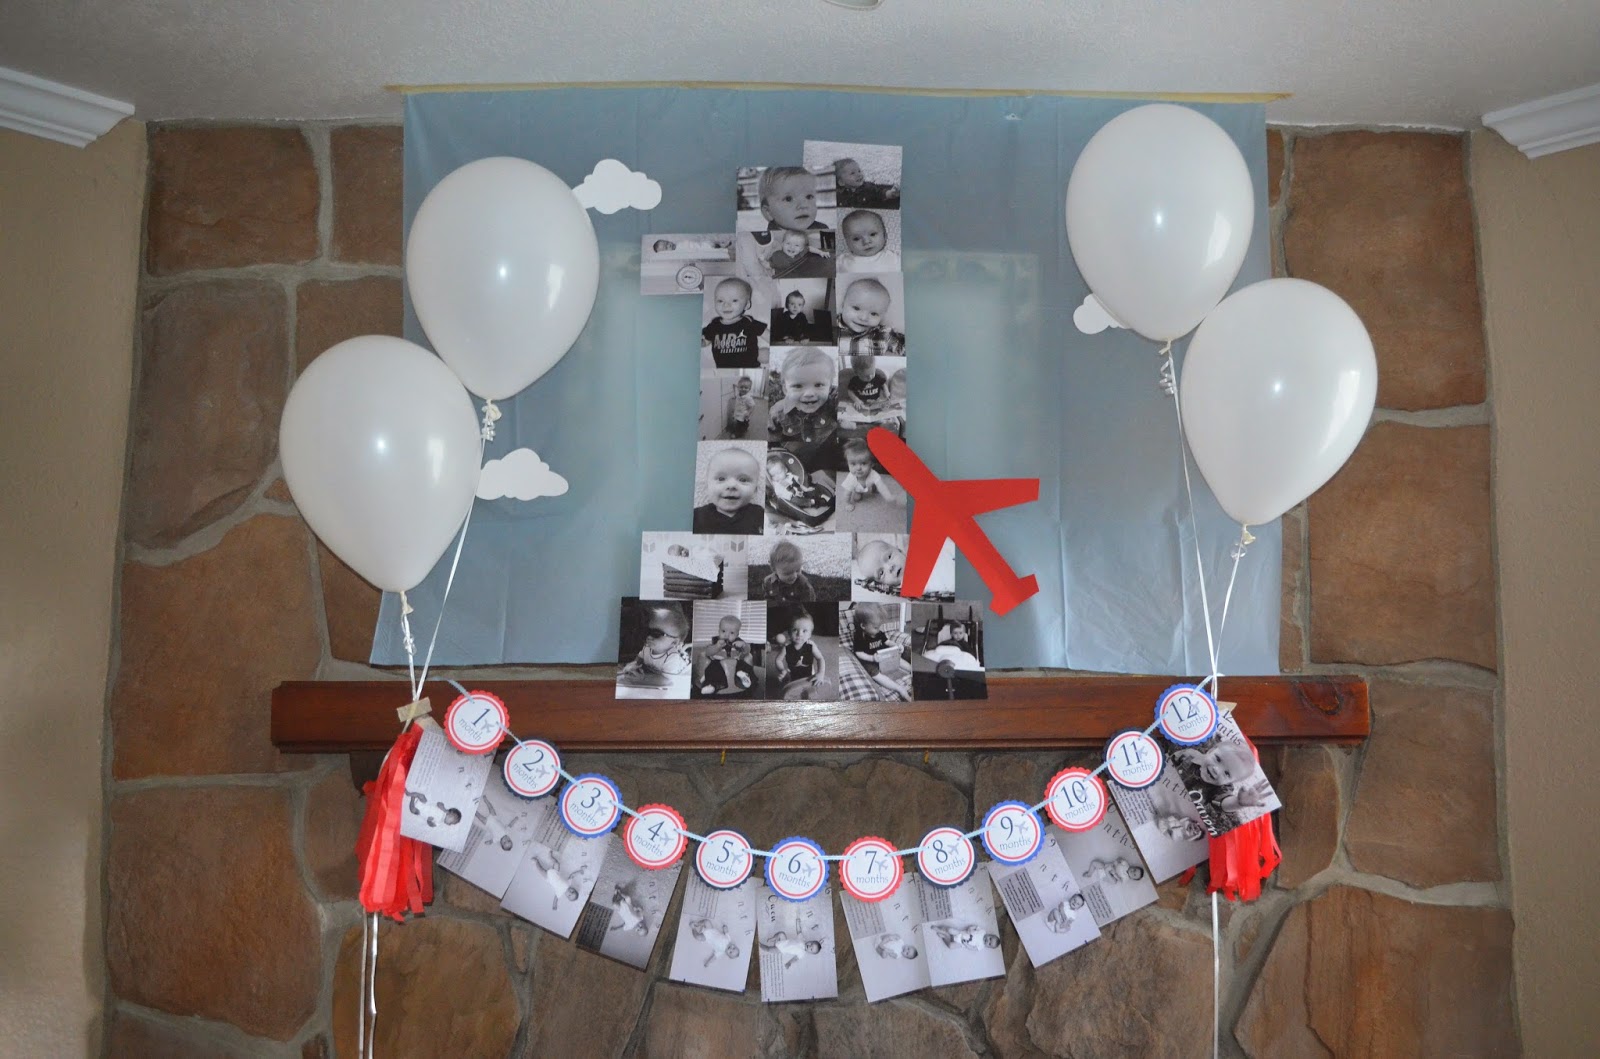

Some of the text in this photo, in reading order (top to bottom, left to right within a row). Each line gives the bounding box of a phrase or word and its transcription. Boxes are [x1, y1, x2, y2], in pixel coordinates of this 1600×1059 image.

[471, 708, 490, 726] 1
[1170, 696, 1198, 723] 12
[459, 718, 482, 742] month
[1178, 713, 1209, 733] months
[522, 749, 544, 772] 2
[1120, 741, 1141, 767] 11
[512, 763, 537, 789] months
[1122, 760, 1154, 777] months
[580, 787, 601, 809] 3
[1061, 780, 1087, 809] 10
[570, 802, 598, 827] months
[1065, 801, 1096, 820] months
[647, 821, 665, 842] 4
[1000, 816, 1013, 840] 9
[634, 835, 663, 856] months
[716, 840, 734, 863] 5
[932, 839, 948, 863] 8
[999, 836, 1032, 851] months
[706, 861, 738, 877] months
[788, 851, 804, 874] 6
[865, 850, 877, 874] 7
[934, 856, 966, 875] months
[778, 871, 811, 888] months
[856, 874, 889, 884] months
